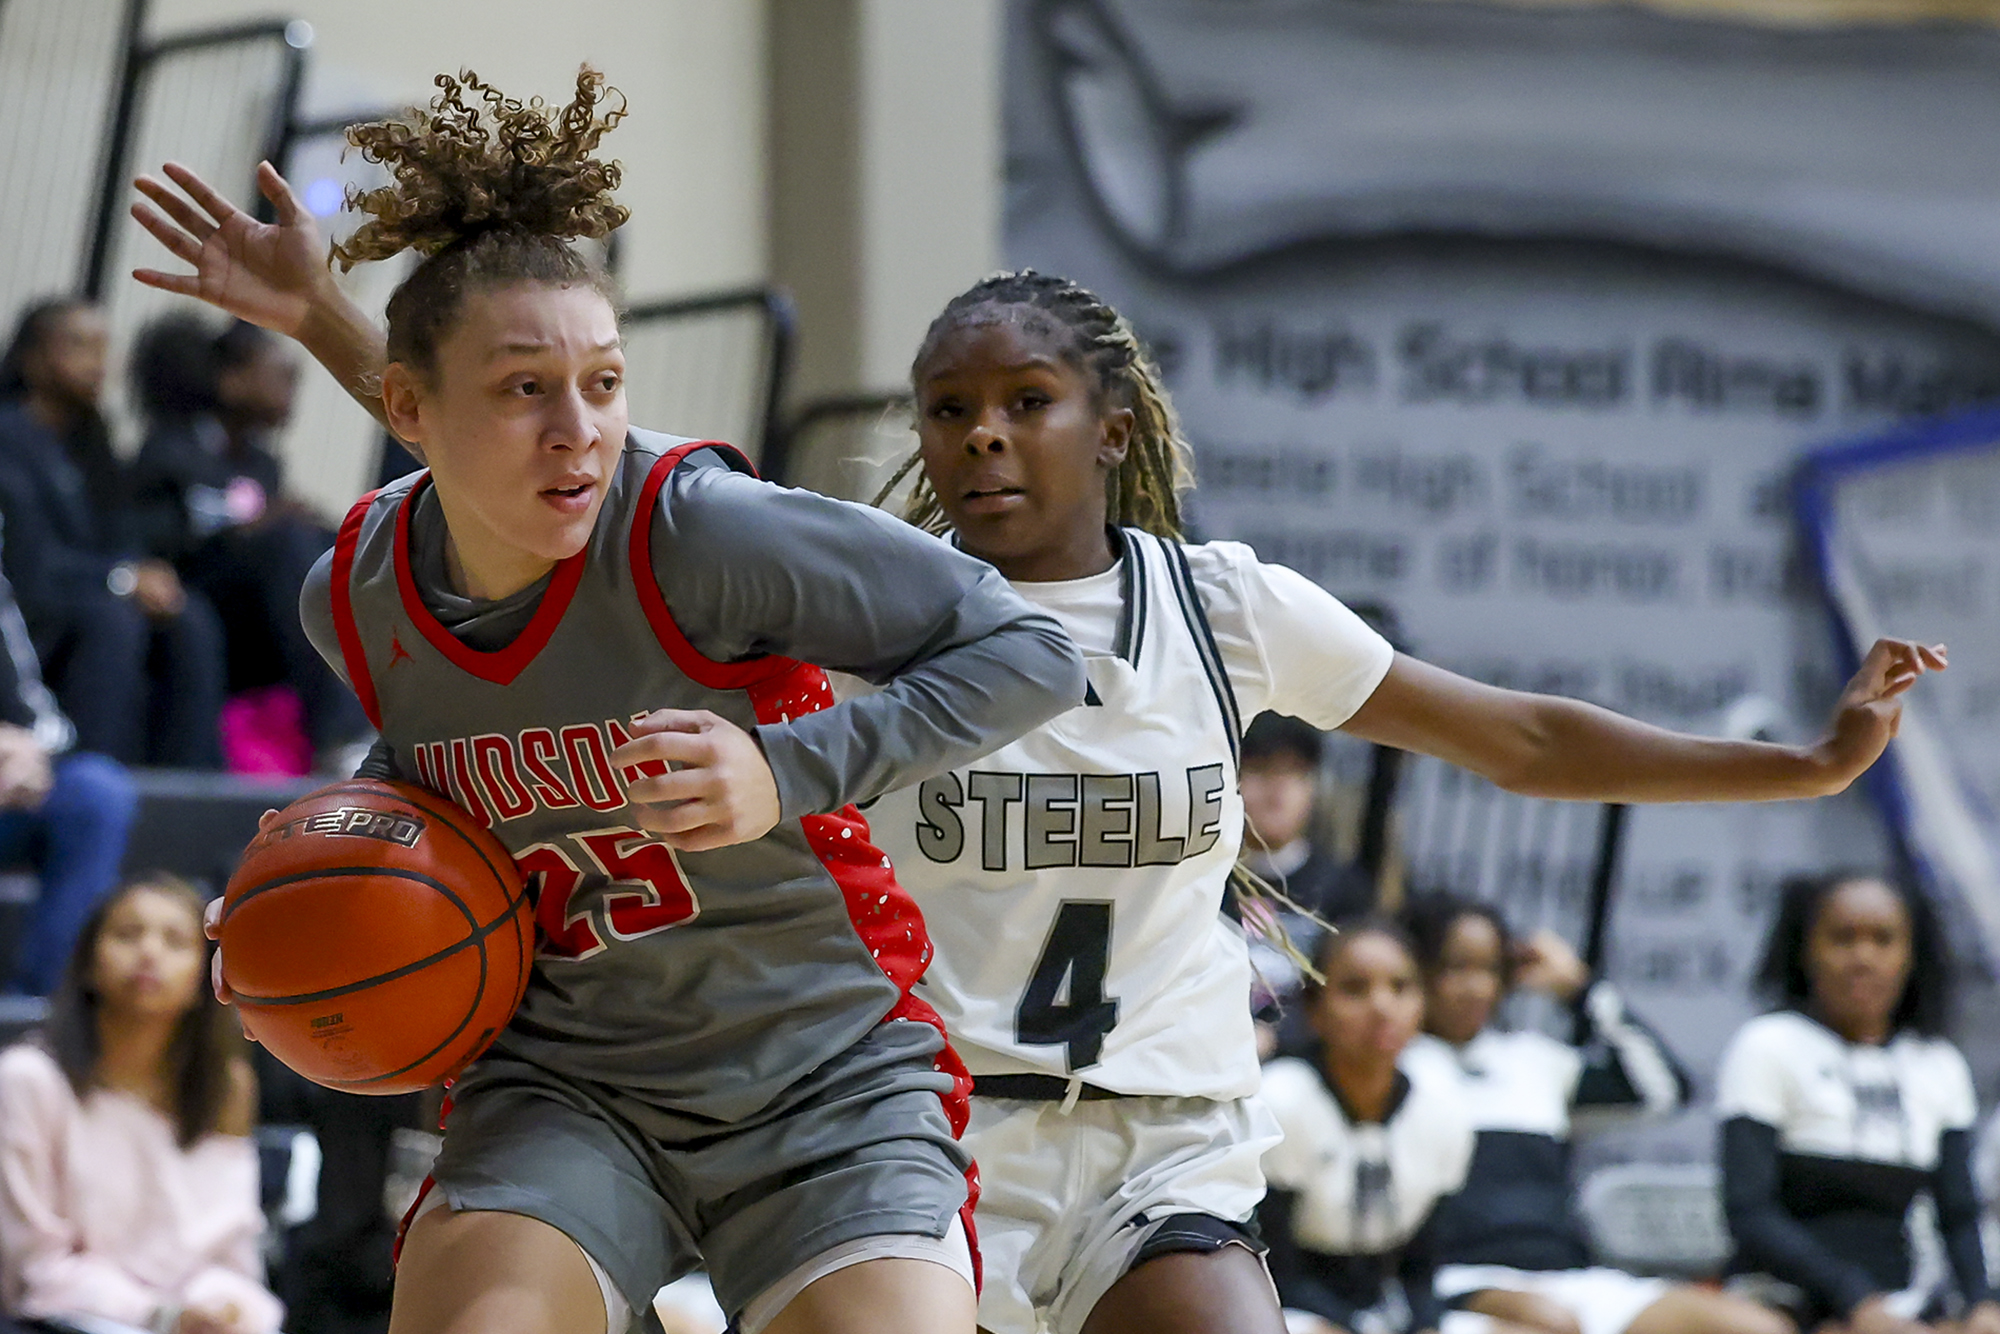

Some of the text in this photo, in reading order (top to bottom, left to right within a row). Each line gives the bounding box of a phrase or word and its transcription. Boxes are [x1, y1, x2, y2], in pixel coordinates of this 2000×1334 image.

[345, 811, 419, 842] PRO
[916, 762, 1224, 871] STEELE
[513, 825, 700, 963] 25
[1013, 899, 1121, 1074] 4
